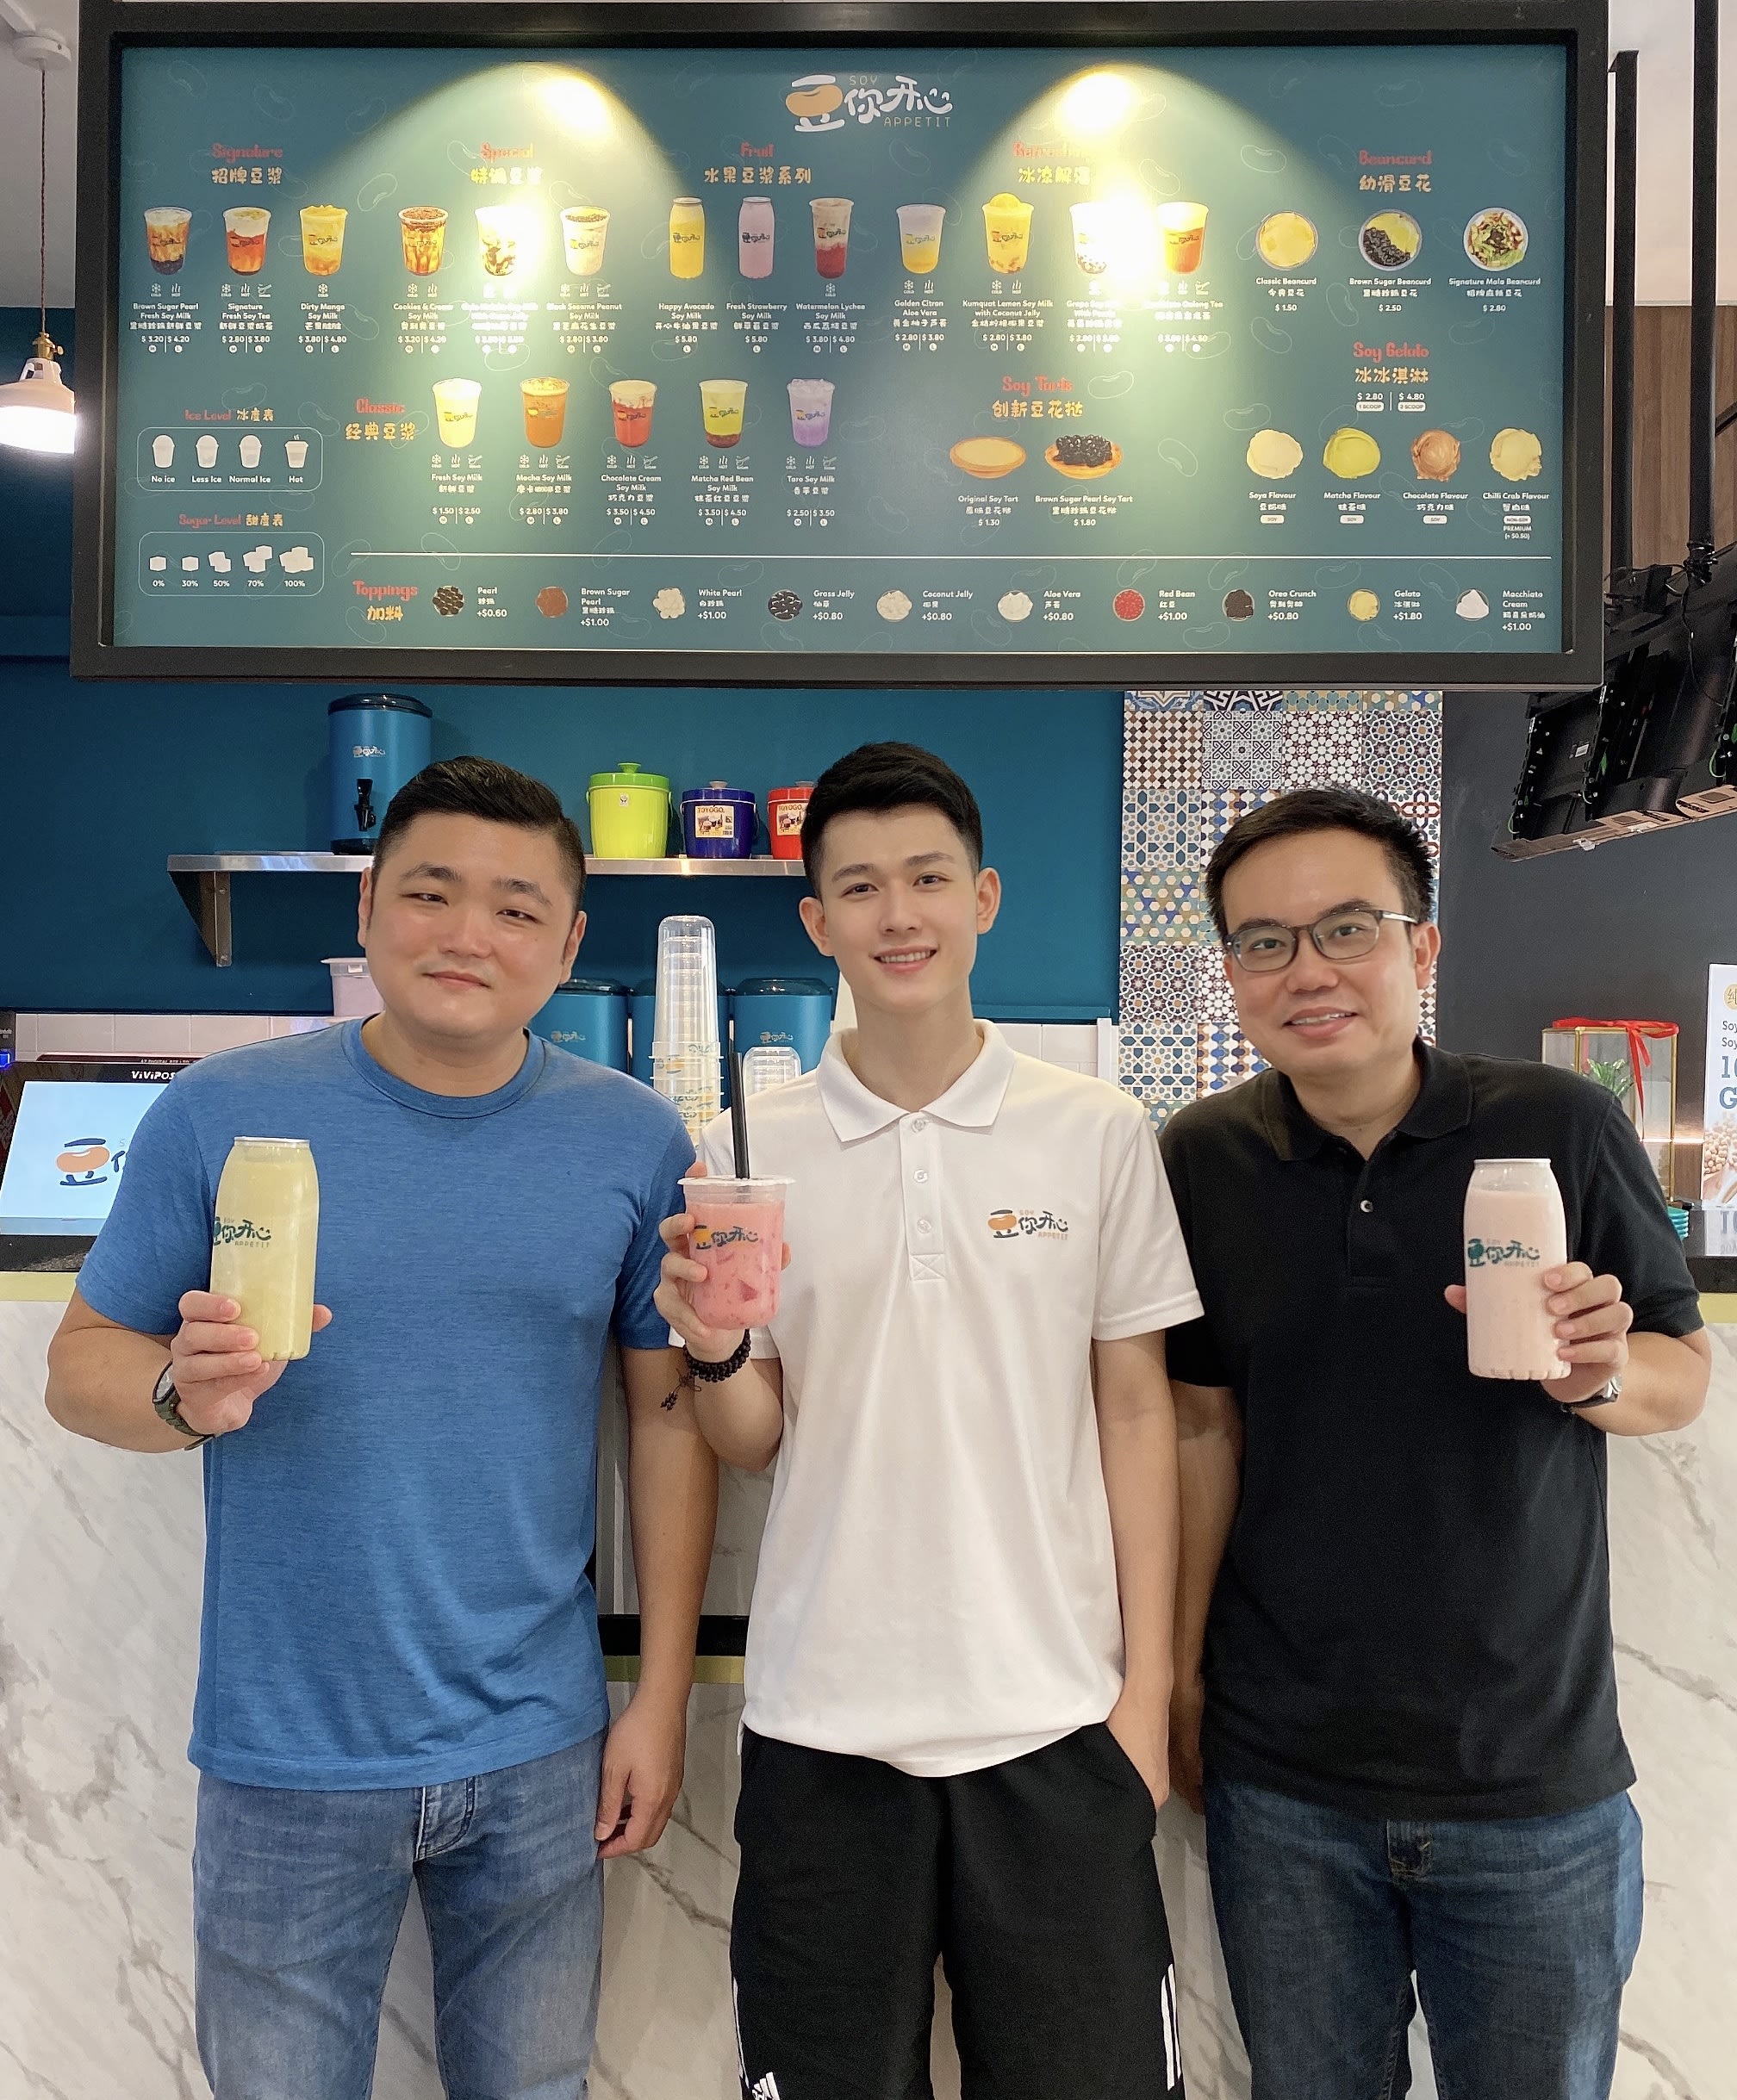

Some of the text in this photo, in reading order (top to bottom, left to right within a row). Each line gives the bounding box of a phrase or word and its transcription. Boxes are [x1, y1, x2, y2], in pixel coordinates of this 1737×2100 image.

[849, 75, 877, 85] SOY
[883, 115, 950, 127] APPETIT
[1373, 278, 1396, 287] Sugar
[1449, 278, 1485, 287] Signature
[228, 302, 264, 312] Signature
[301, 303, 346, 312] Dirty Mango
[658, 303, 714, 313] Happy Avocado
[841, 303, 865, 312] Lychee
[962, 300, 996, 310] Kumquat
[1023, 300, 1037, 310] Soy
[161, 312, 175, 320] Soy
[243, 313, 257, 321] Soy
[742, 312, 755, 320] Soy
[815, 312, 829, 320] Soy
[1024, 309, 1041, 318] Jelly
[452, 474, 465, 482] Soy
[541, 474, 555, 483] Soy
[805, 475, 819, 484] Soy
[958, 495, 987, 504] Original
[989, 495, 1002, 504] Soy
[1059, 495, 1082, 505] Sugar
[1083, 494, 1102, 503] Pearl
[1103, 495, 1117, 504] Soy
[1249, 492, 1267, 500] Soya
[607, 588, 630, 597] Sugar
[837, 590, 855, 599] Jelly
[956, 590, 974, 600] Jelly
